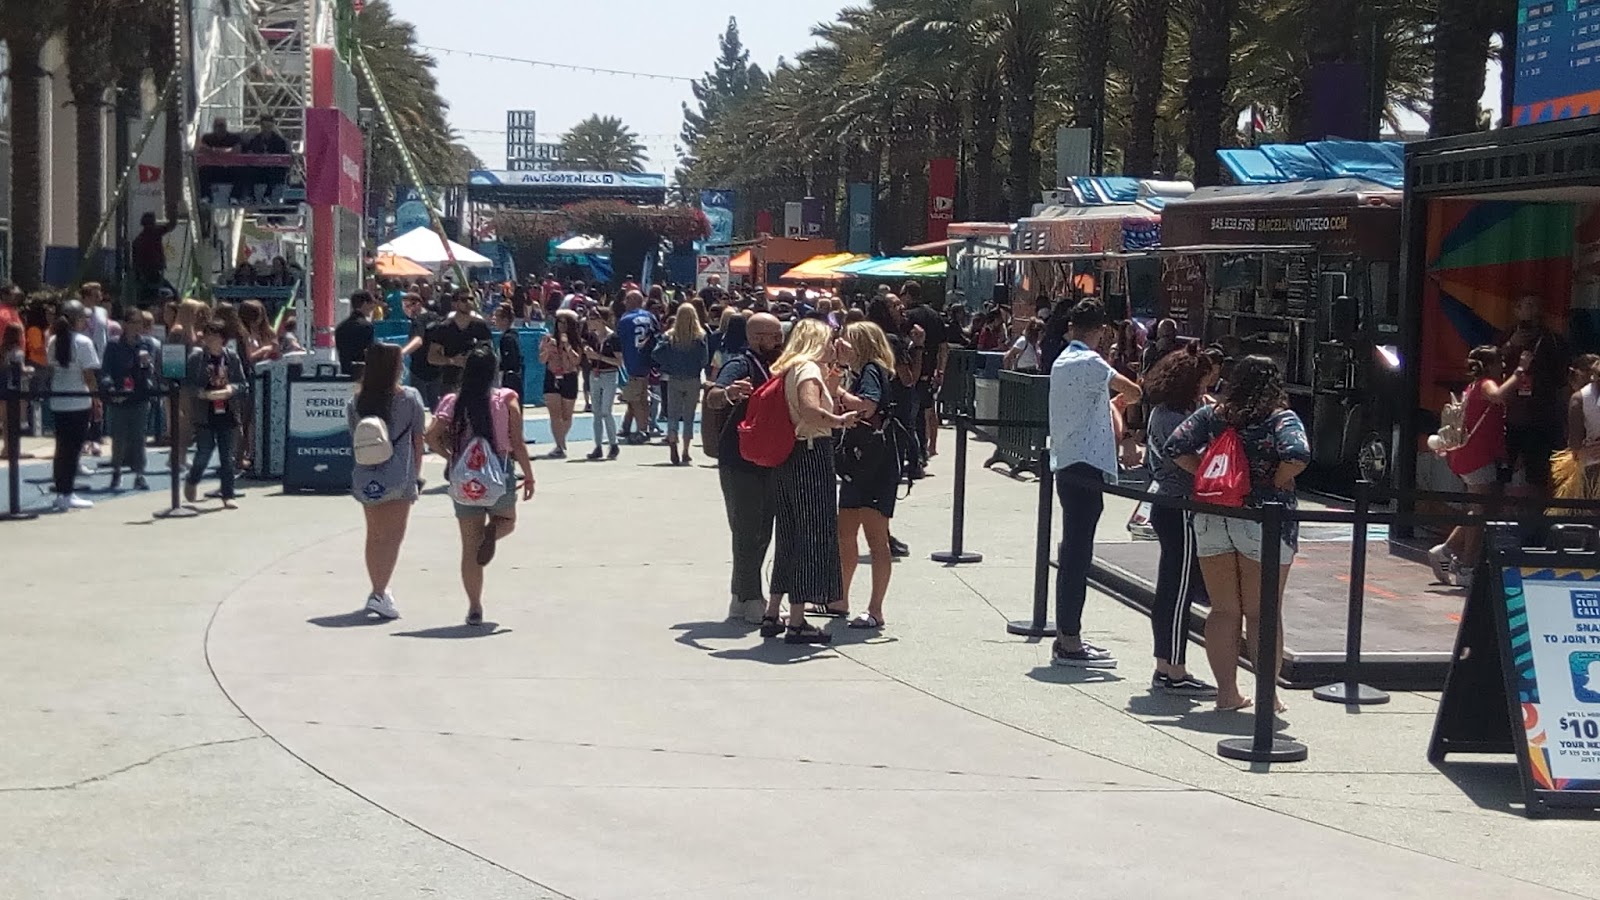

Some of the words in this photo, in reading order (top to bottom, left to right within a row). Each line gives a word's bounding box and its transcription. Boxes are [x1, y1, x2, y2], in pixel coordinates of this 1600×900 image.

[306, 398, 346, 407] FERRIS
[305, 409, 346, 418] WHEEL
[297, 447, 353, 456] ENTRANCE
[1576, 623, 1600, 631] SNA
[1543, 634, 1558, 643] TO
[1562, 634, 1587, 644] JOIN
[1560, 716, 1599, 739] $10
[1559, 740, 1585, 748] YOUR
